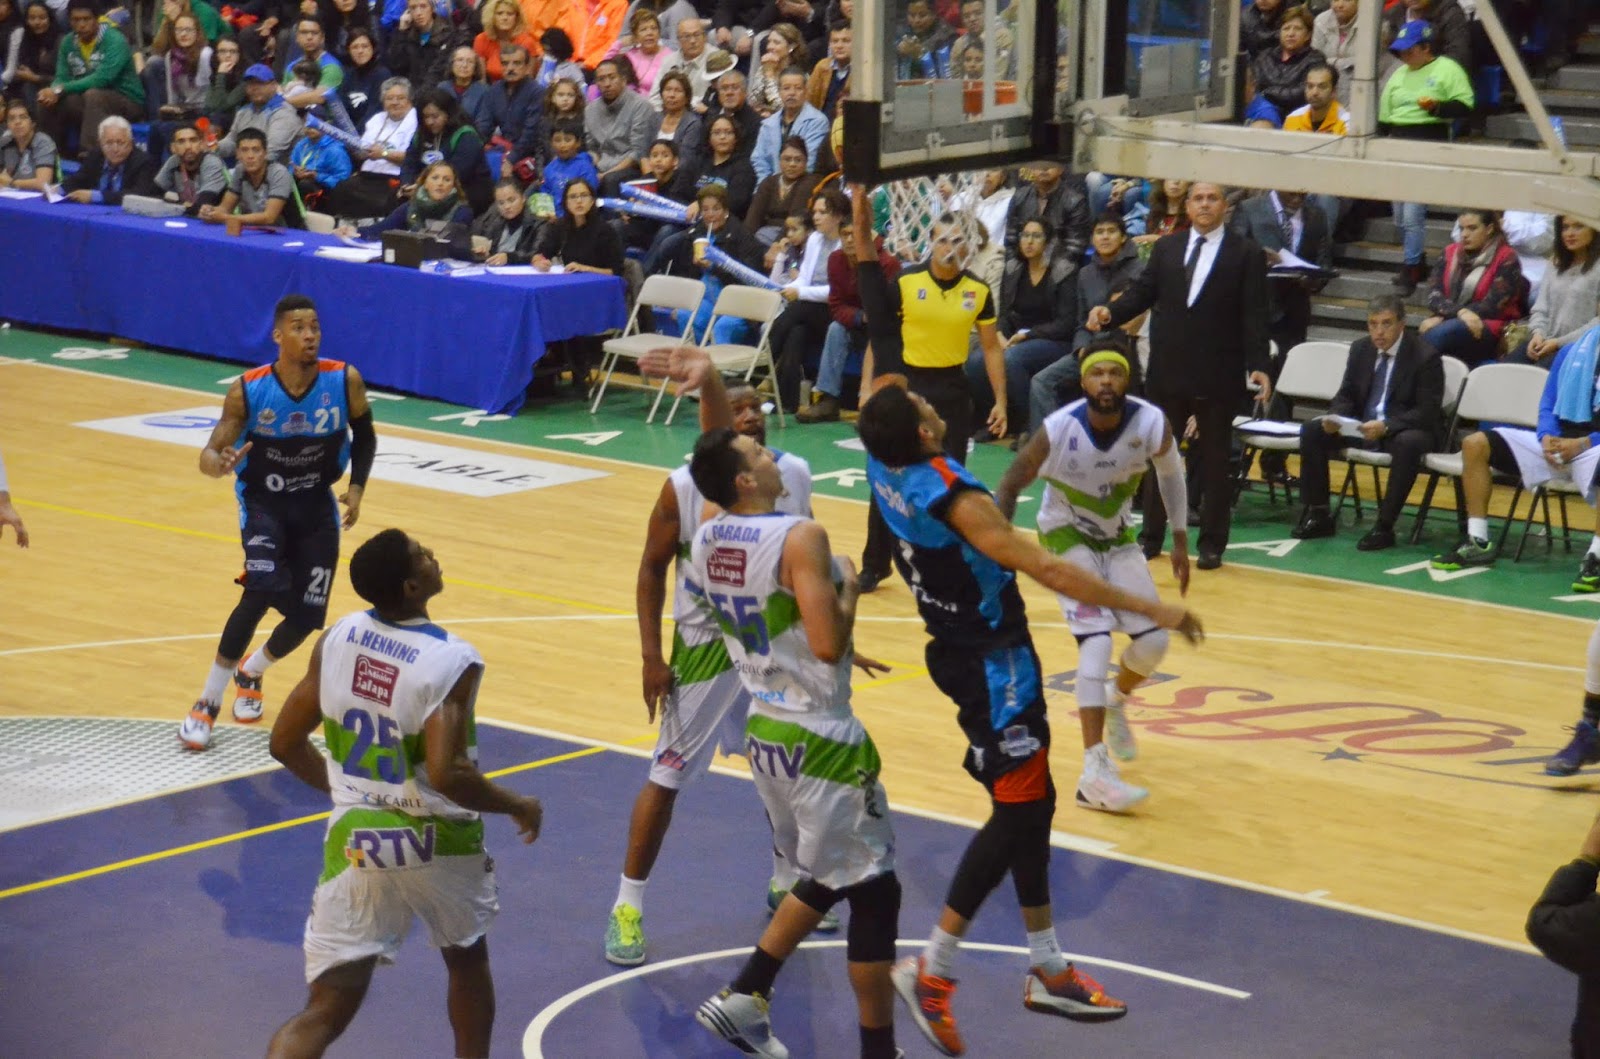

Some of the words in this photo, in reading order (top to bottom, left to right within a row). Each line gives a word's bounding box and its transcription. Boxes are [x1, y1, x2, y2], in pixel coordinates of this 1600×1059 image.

[314, 406, 341, 433] 21
[374, 452, 547, 488] CABLE
[712, 524, 762, 544] PARADA
[308, 566, 332, 595] 21
[709, 592, 771, 657] 55
[346, 626, 359, 645] A.
[360, 629, 421, 664] HENNING
[342, 707, 407, 786] 25
[750, 734, 807, 779] RTV
[353, 824, 437, 869] RTV
